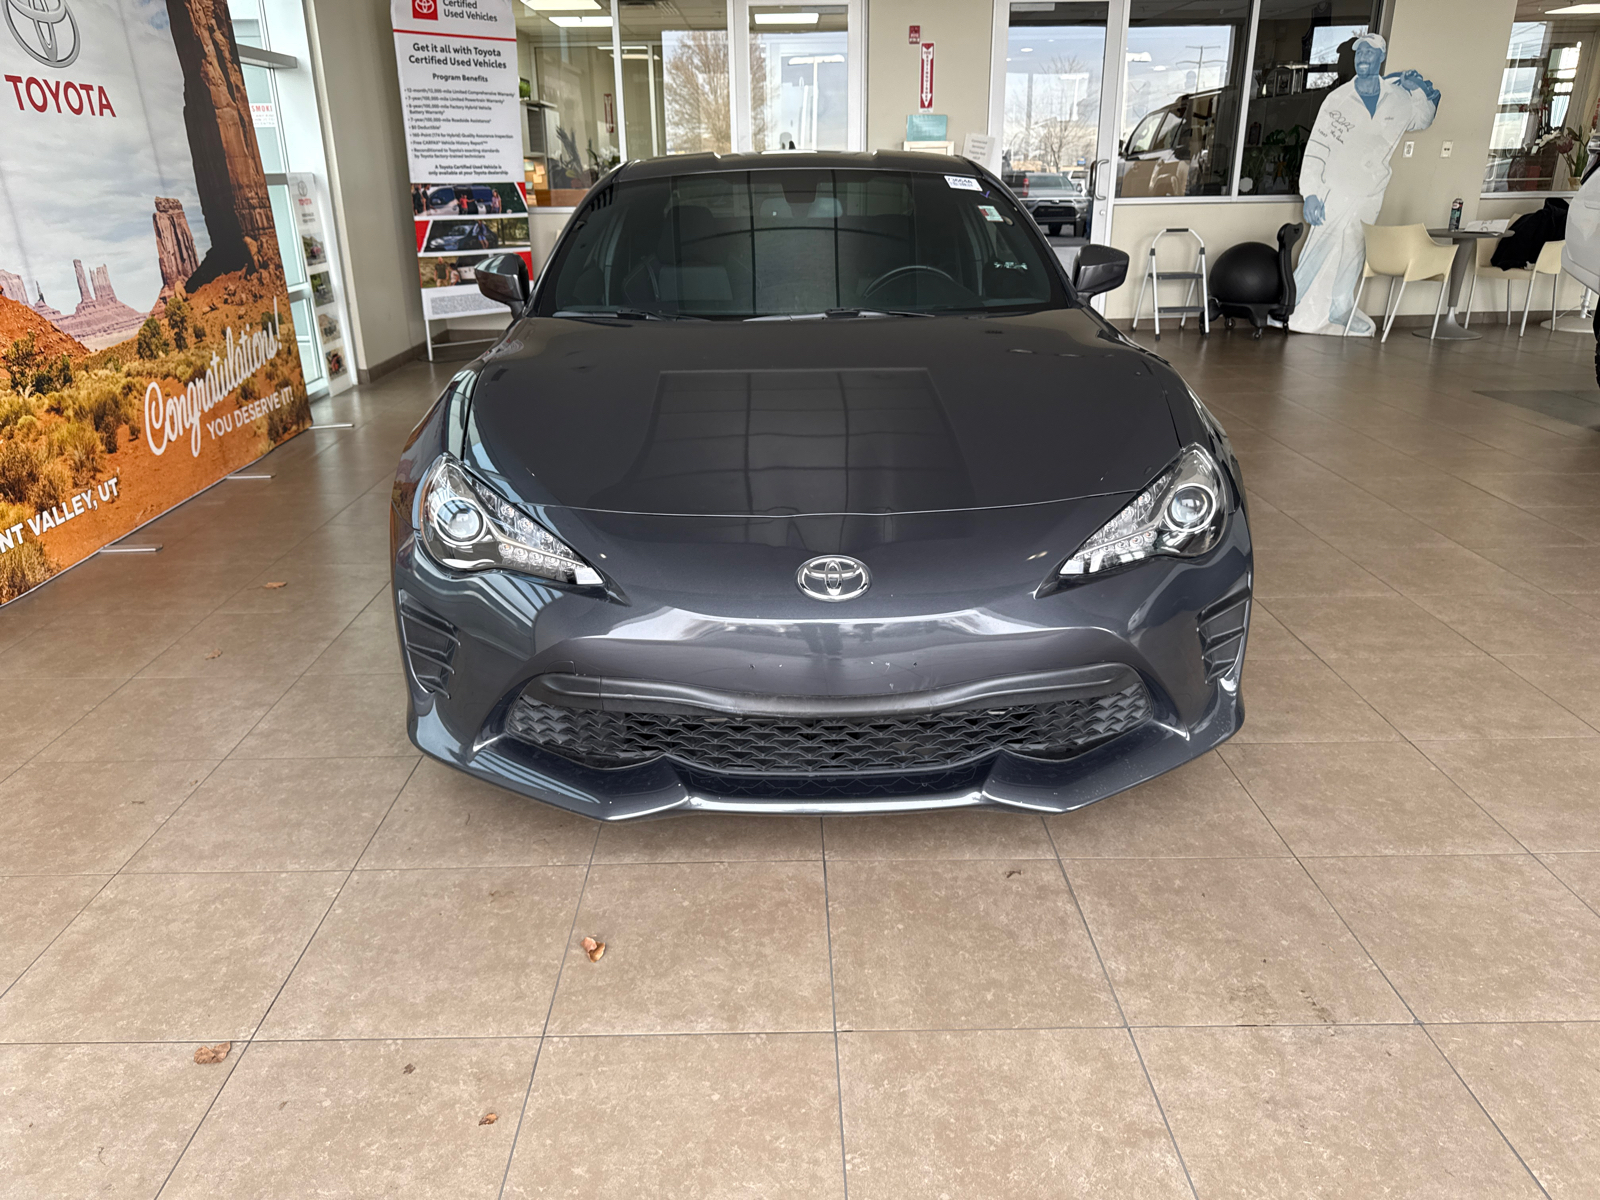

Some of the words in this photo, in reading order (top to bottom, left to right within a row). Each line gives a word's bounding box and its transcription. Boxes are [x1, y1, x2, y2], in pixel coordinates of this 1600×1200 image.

[443, 0, 477, 9] Certified
[444, 9, 464, 18] Used
[466, 11, 498, 22] Vehicles
[412, 43, 429, 52] Get
[431, 44, 438, 53] it
[440, 45, 451, 54] all
[452, 46, 472, 55] with
[473, 47, 502, 58] Toyota
[408, 55, 448, 66] Certified
[449, 57, 472, 67] Used
[472, 58, 507, 69] Vehicles
[432, 73, 461, 82] Program
[462, 74, 488, 82] Benefits
[4, 74, 116, 118] TOYOTA
[145, 295, 282, 458] Congratulations!
[206, 414, 233, 440] YOU
[234, 392, 280, 428] DESERVE
[281, 386, 294, 405] IT!
[27, 489, 98, 536] VALLEY,
[98, 478, 118, 502] UT
